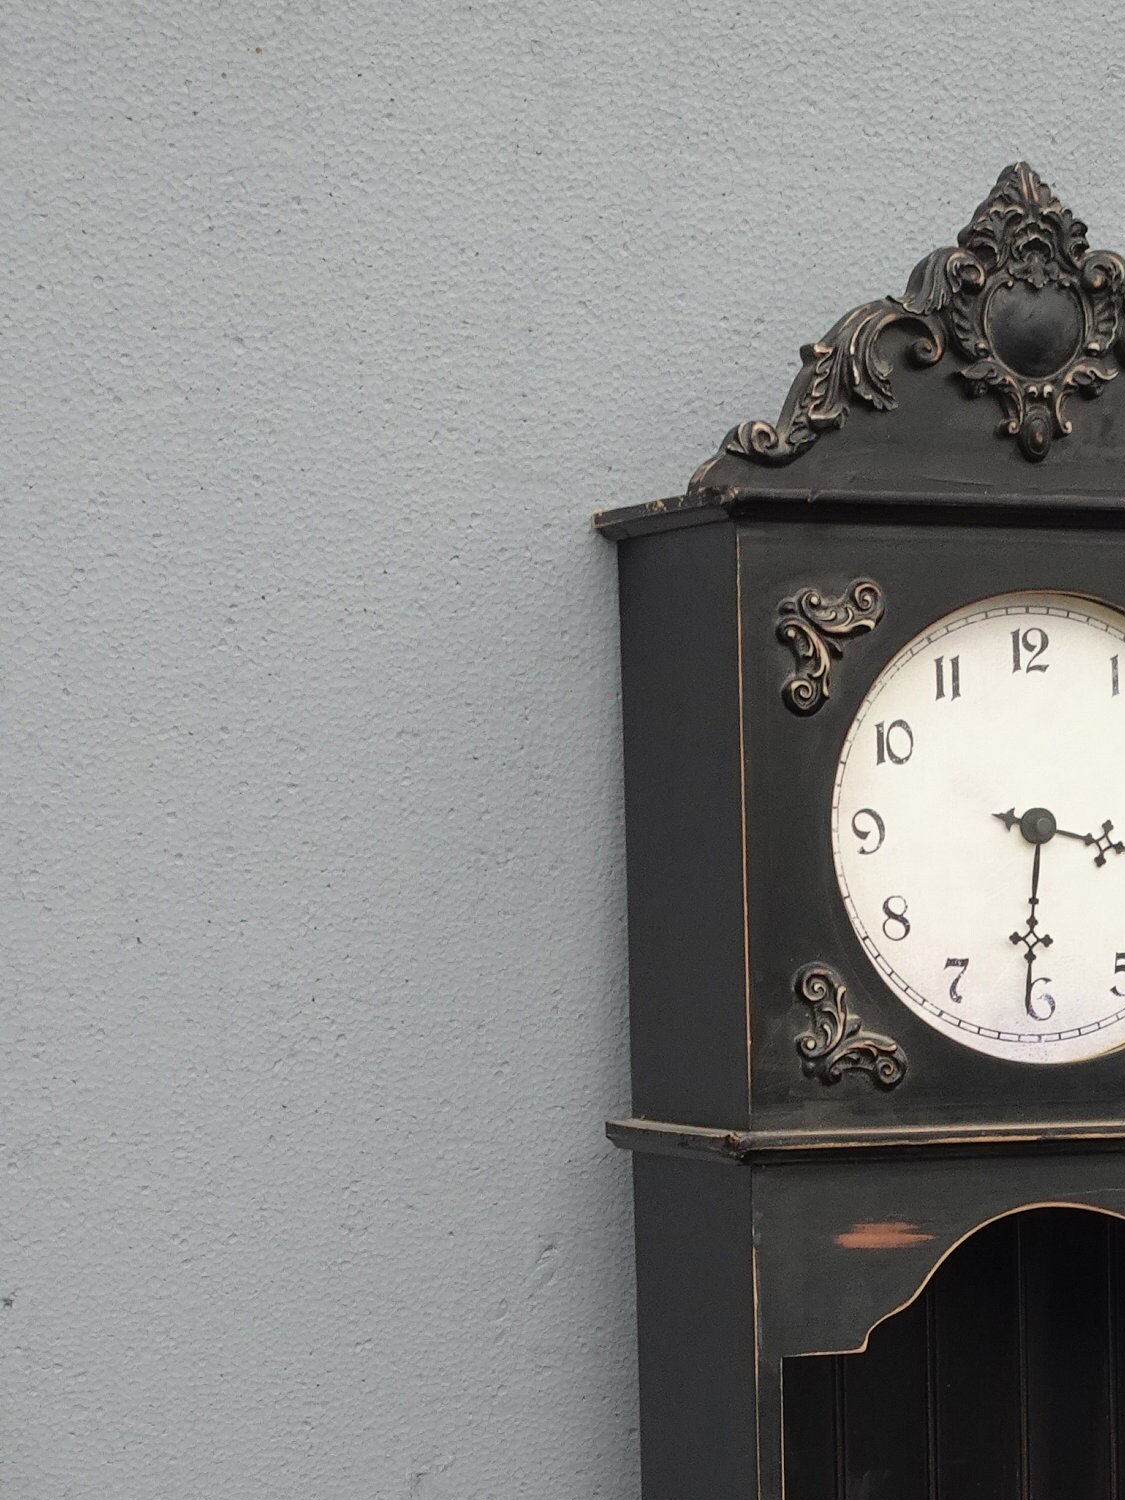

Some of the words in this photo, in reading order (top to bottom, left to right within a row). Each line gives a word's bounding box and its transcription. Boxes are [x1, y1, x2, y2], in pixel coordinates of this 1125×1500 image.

[1011, 628, 1049, 673] 12
[935, 655, 961, 701] 11
[1110, 654, 1120, 697] 1
[875, 720, 913, 765] 10
[852, 809, 885, 854] 9
[883, 896, 910, 941] 8
[944, 958, 969, 1003] 7
[1027, 977, 1056, 1021] 6
